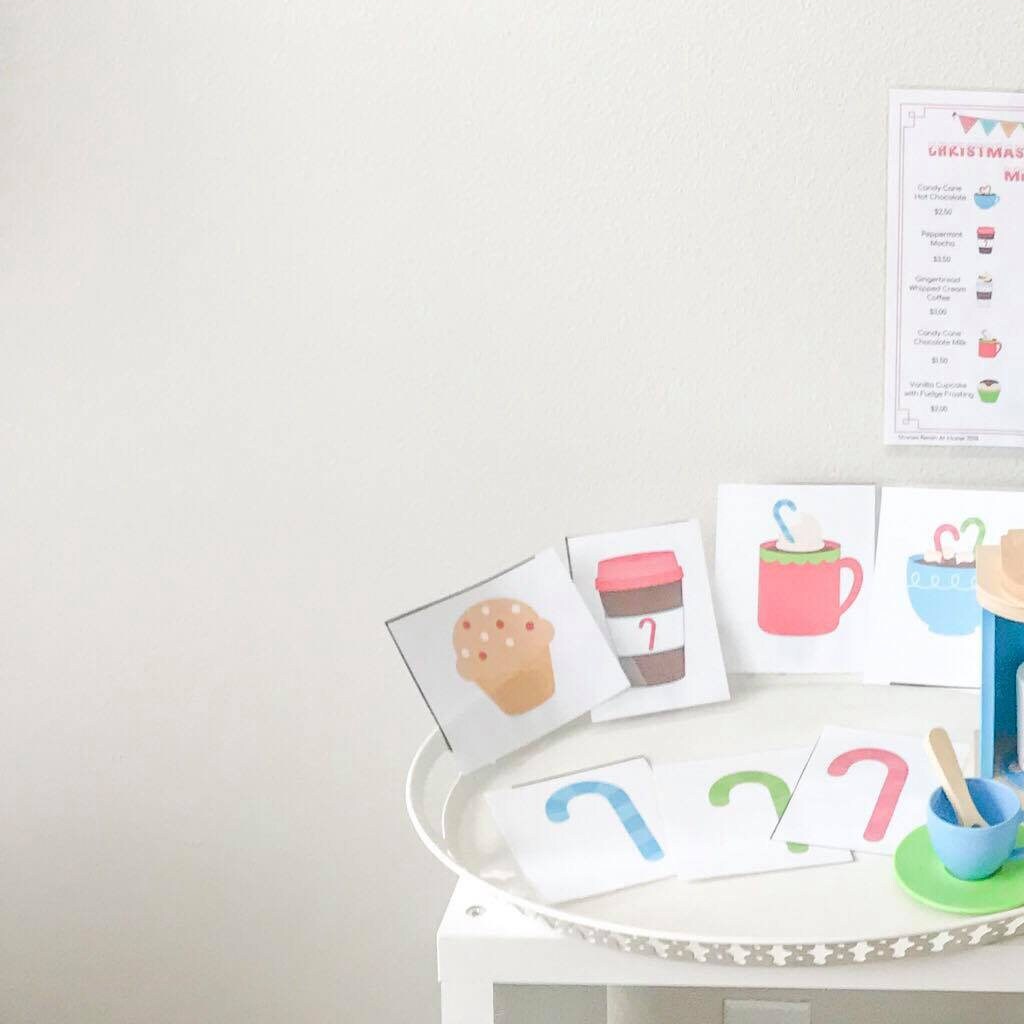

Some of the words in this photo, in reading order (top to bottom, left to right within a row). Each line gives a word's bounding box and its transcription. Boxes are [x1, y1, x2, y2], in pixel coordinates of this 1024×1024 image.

[928, 144, 1024, 159] CHRISTMAS
[917, 184, 941, 192] Candy
[943, 184, 962, 192] Cane
[914, 193, 928, 201] Hot
[929, 193, 967, 201] Chocolate
[921, 230, 963, 239] Peppermint
[930, 240, 956, 248] Mocha
[914, 275, 961, 284] Gingerbread
[909, 285, 941, 294] Whipped
[943, 285, 967, 293] Cream
[926, 294, 951, 302] Coffee
[917, 329, 941, 338] Candy
[943, 329, 962, 337] Cane
[913, 338, 951, 346] Chocolate
[952, 338, 967, 346] Milk
[910, 381, 935, 389] Vanilla
[936, 381, 967, 390] Cupcake
[920, 390, 943, 399] Fudge
[944, 391, 975, 400] Frosting
